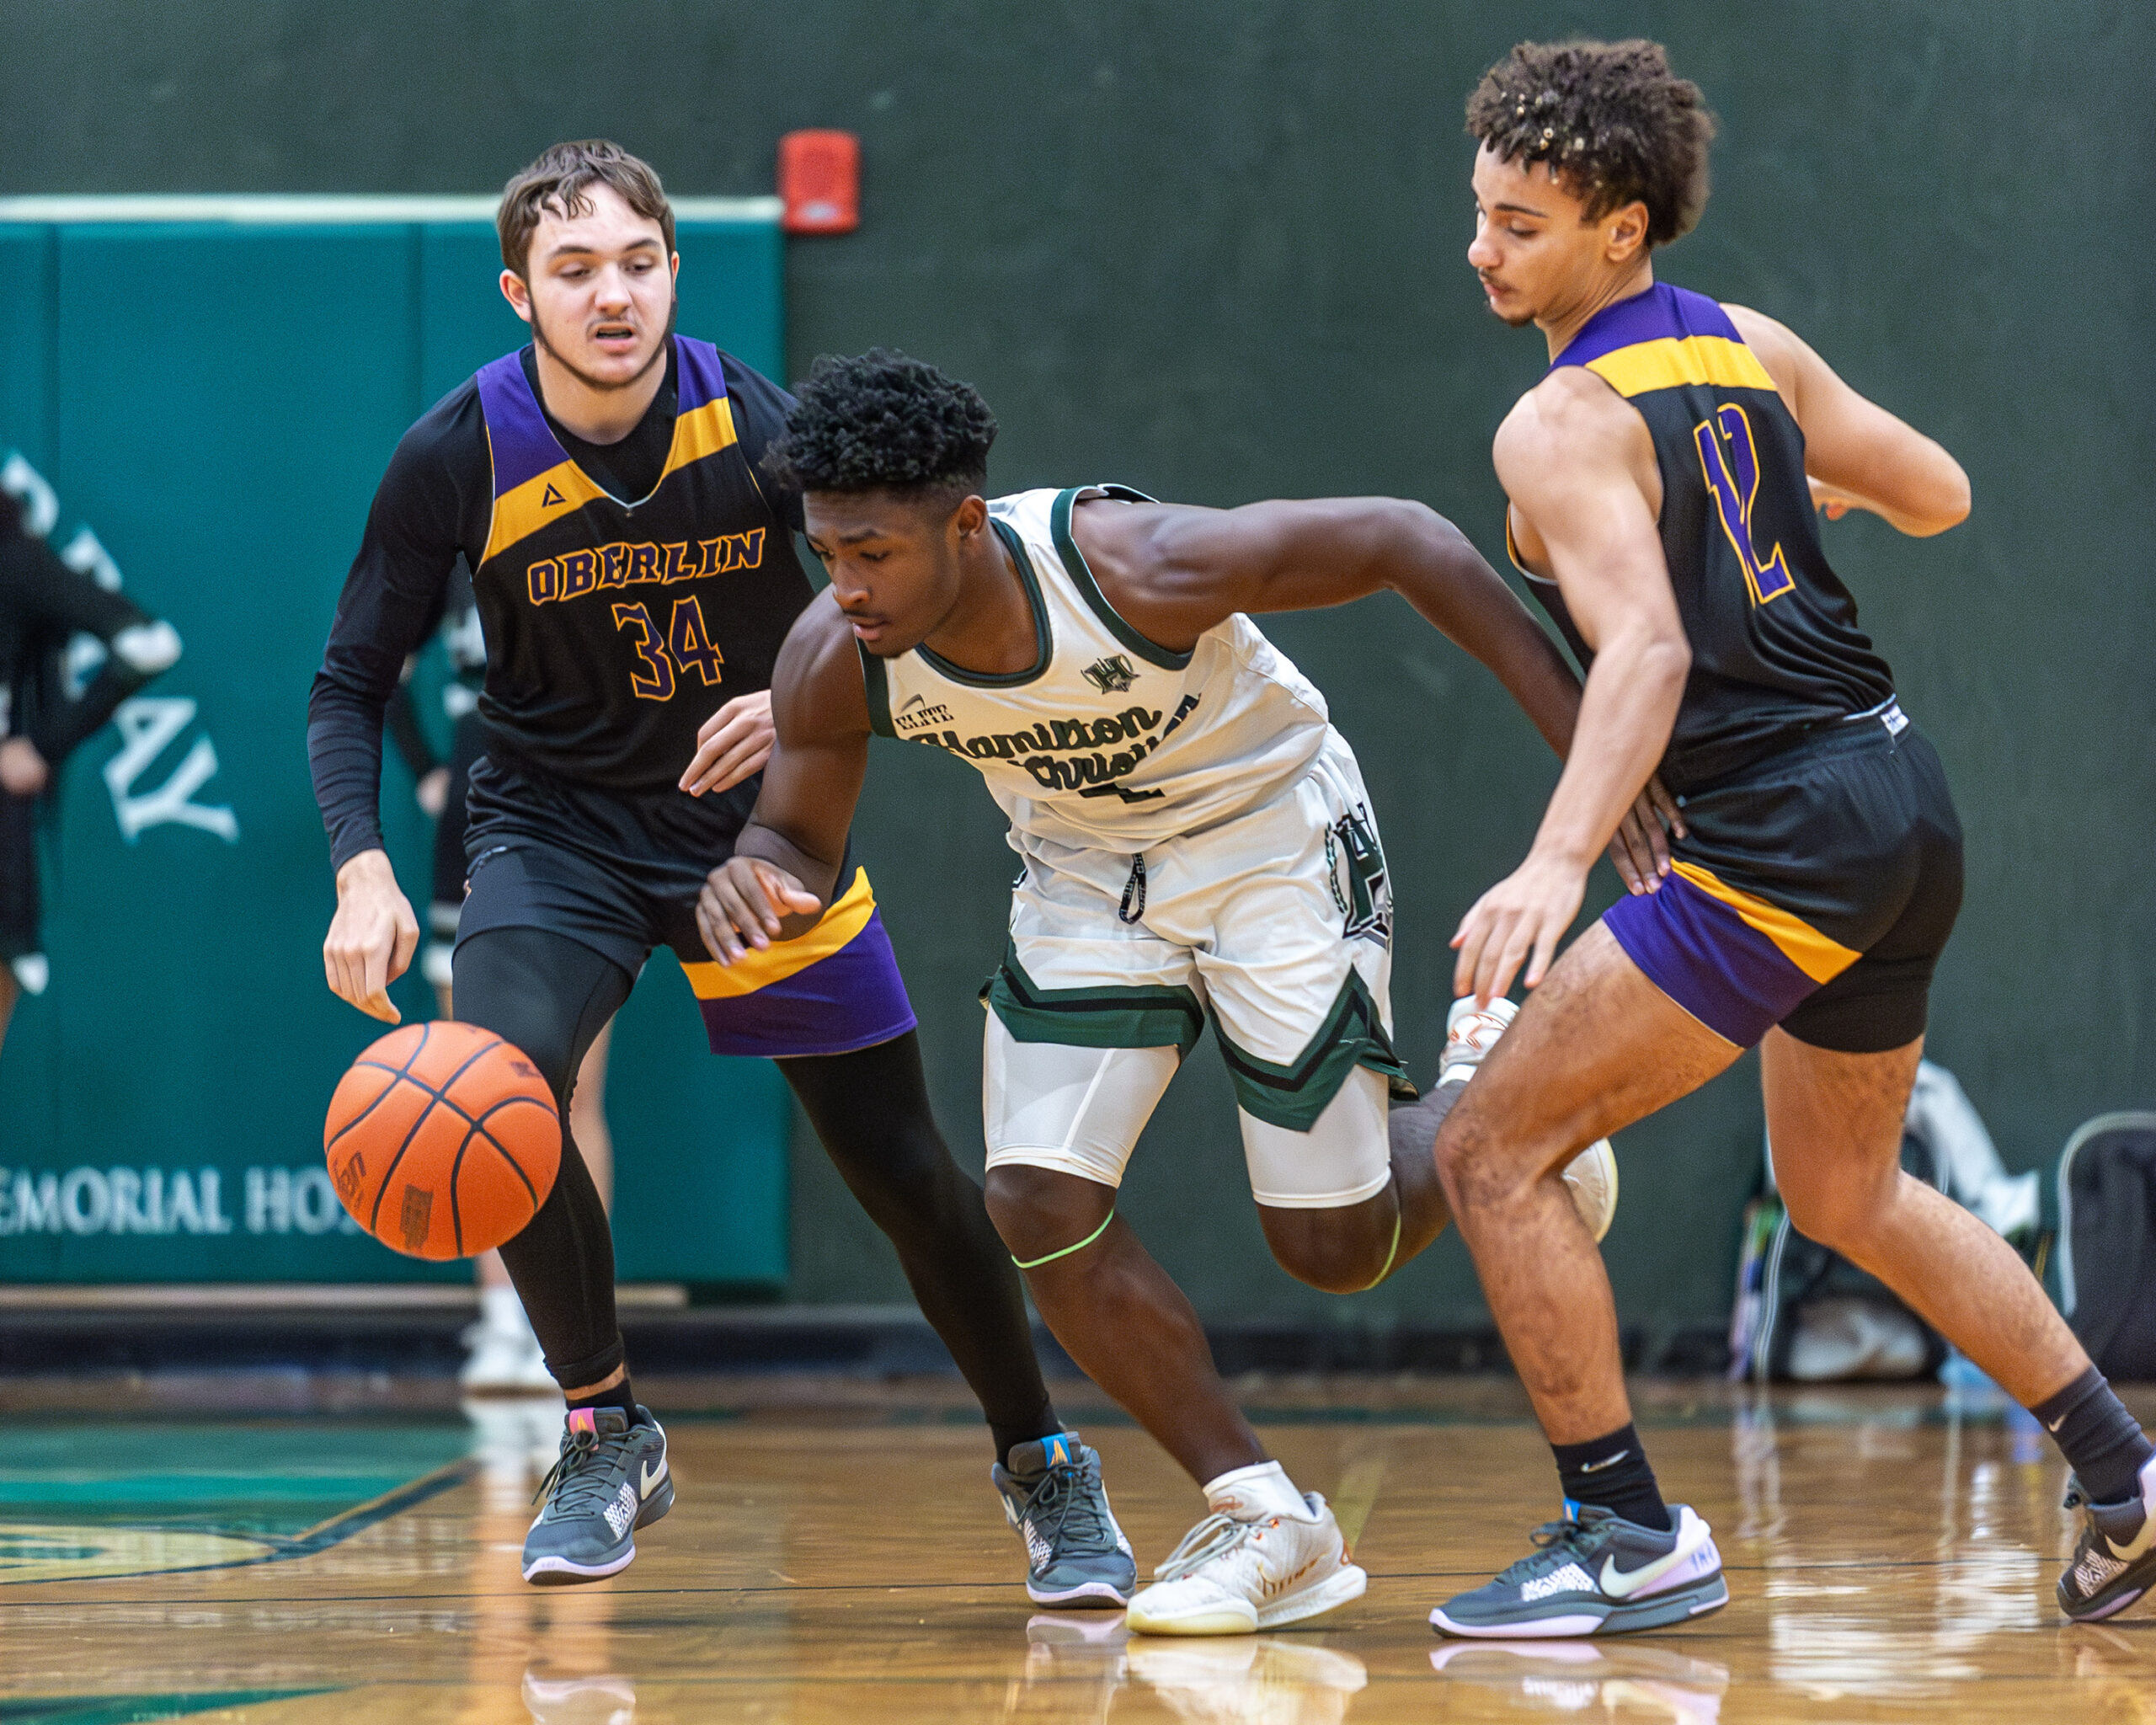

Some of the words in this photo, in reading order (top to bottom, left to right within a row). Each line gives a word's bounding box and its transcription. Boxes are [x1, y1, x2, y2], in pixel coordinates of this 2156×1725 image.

[1693, 402, 1796, 610] 12
[527, 526, 766, 606] OBERLIN
[611, 595, 724, 702] 34
[894, 704, 954, 730] ELITE
[245, 1166, 362, 1236] HO
